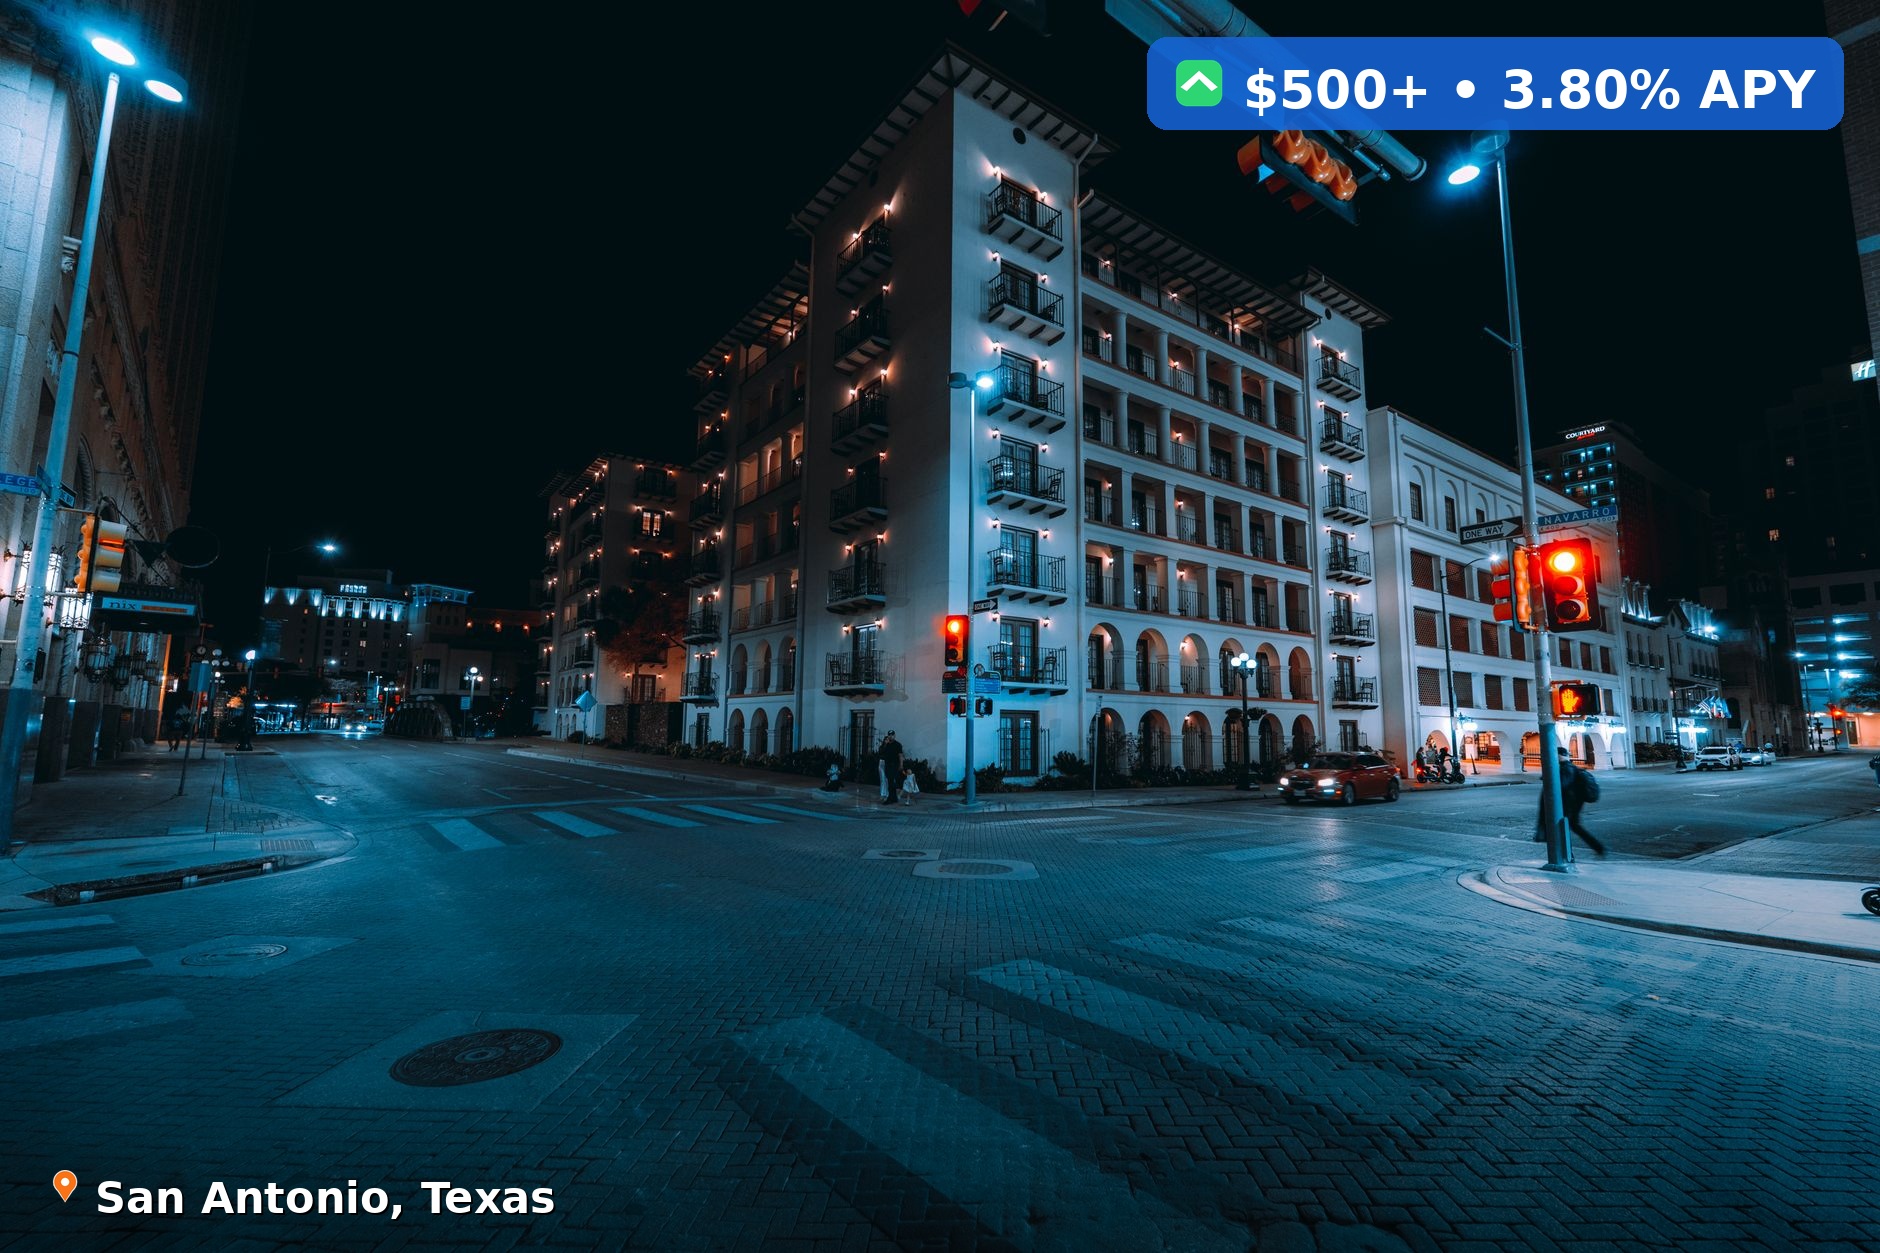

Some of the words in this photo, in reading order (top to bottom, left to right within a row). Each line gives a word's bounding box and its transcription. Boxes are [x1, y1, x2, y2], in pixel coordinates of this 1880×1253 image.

[1565, 426, 1606, 439] COURTYARD
[0, 475, 36, 487] EGE
[1544, 507, 1610, 525] NAVARRO
[1465, 529, 1483, 539] ONE
[1485, 524, 1504, 535] WAY
[109, 600, 137, 610] nix
